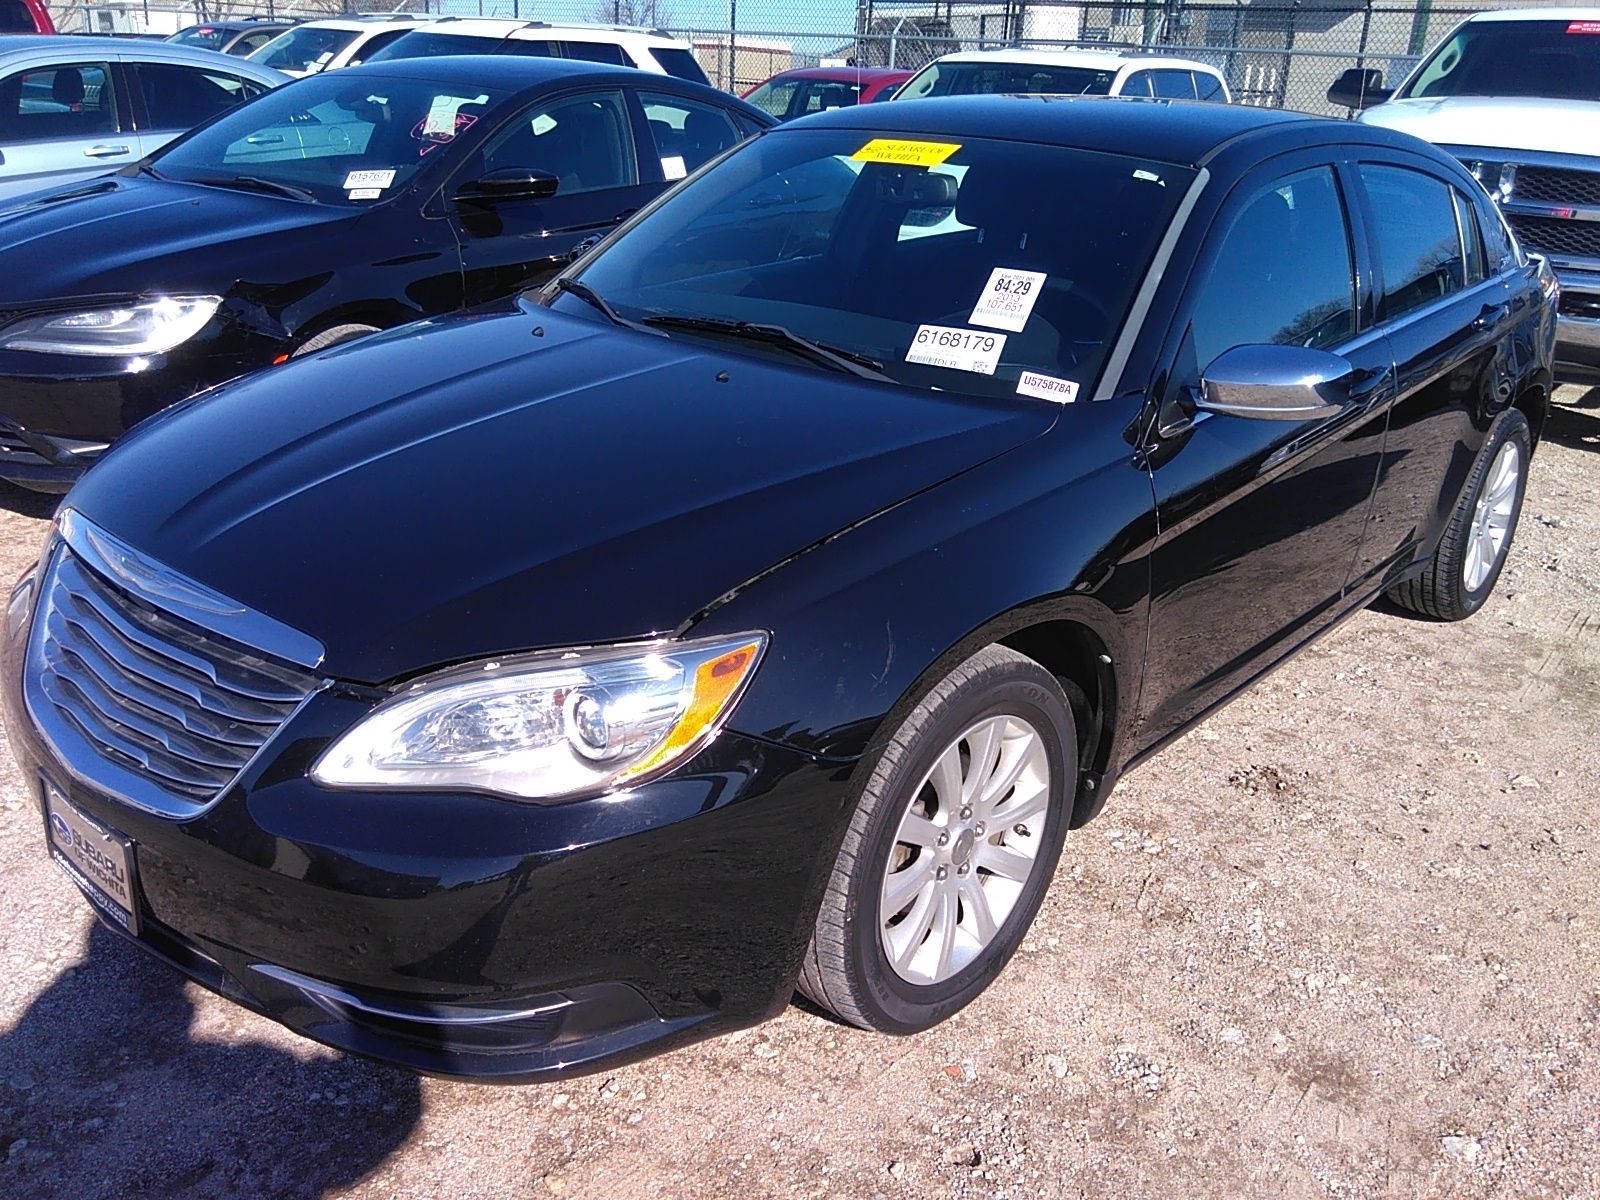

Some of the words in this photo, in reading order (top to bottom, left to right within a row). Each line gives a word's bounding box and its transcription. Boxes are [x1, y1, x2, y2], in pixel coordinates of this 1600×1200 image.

[994, 278, 1031, 295] 84:29
[997, 292, 1020, 303] 2013
[917, 329, 995, 352] 6168179
[1024, 375, 1071, 395] U575878A
[72, 827, 125, 884] SUBARU
[75, 847, 85, 862] OF
[86, 857, 127, 900] WICHITA
